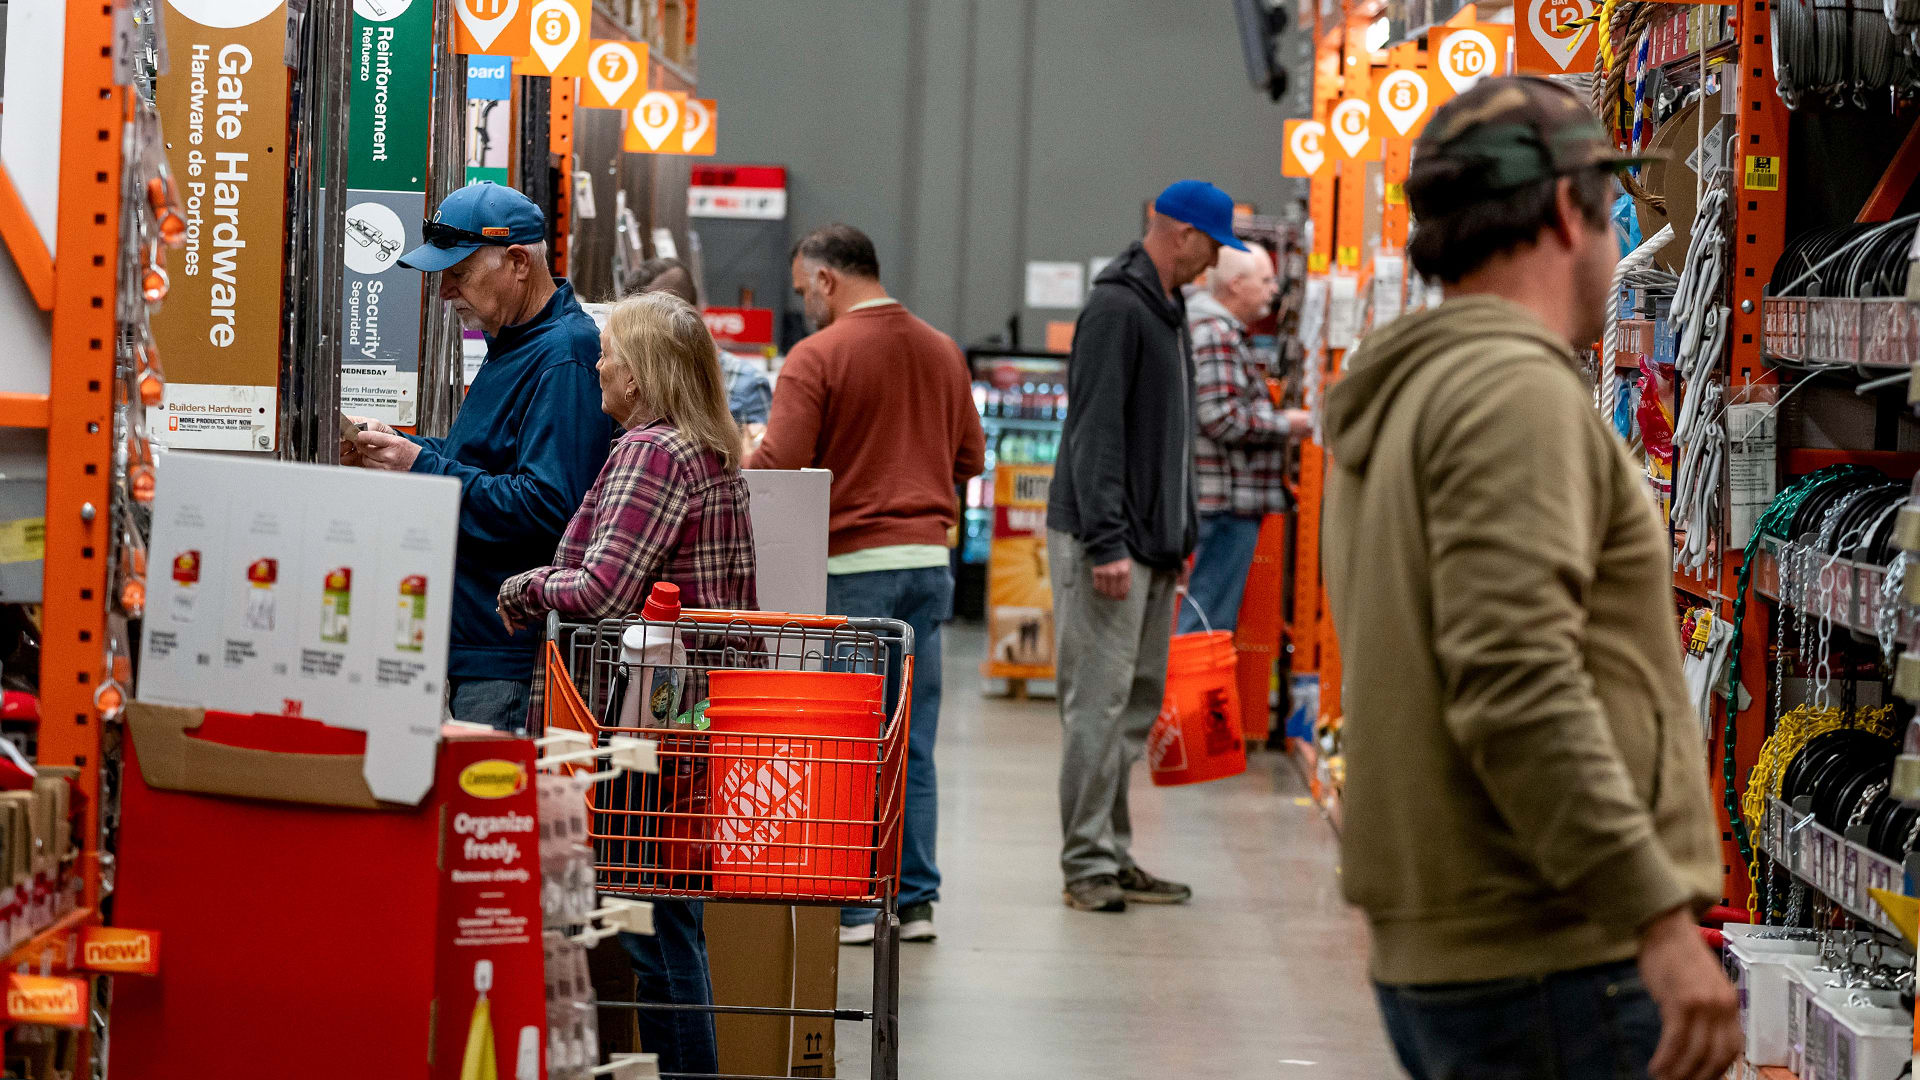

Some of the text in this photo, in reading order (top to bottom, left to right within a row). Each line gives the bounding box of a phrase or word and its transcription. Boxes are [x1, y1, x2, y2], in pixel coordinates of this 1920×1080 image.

[545, 19, 561, 40] 9
[1545, 7, 1580, 32] 12
[360, 26, 374, 82] Refuerzo
[1452, 51, 1483, 72] 10
[605, 61, 620, 79] 7
[372, 26, 394, 162] Reinforcement
[1395, 88, 1412, 107] 8
[185, 44, 210, 276] Hardware de Portones
[209, 43, 253, 348] Gate Hardware
[348, 280, 363, 345] Seguridad
[361, 280, 384, 359] Security
[169, 403, 252, 414] Builders Hardware
[717, 757, 753, 804] THE
[714, 745, 802, 862] HOME
[454, 811, 534, 839] Organize
[464, 837, 521, 864] freely.
[86, 937, 149, 963] new!
